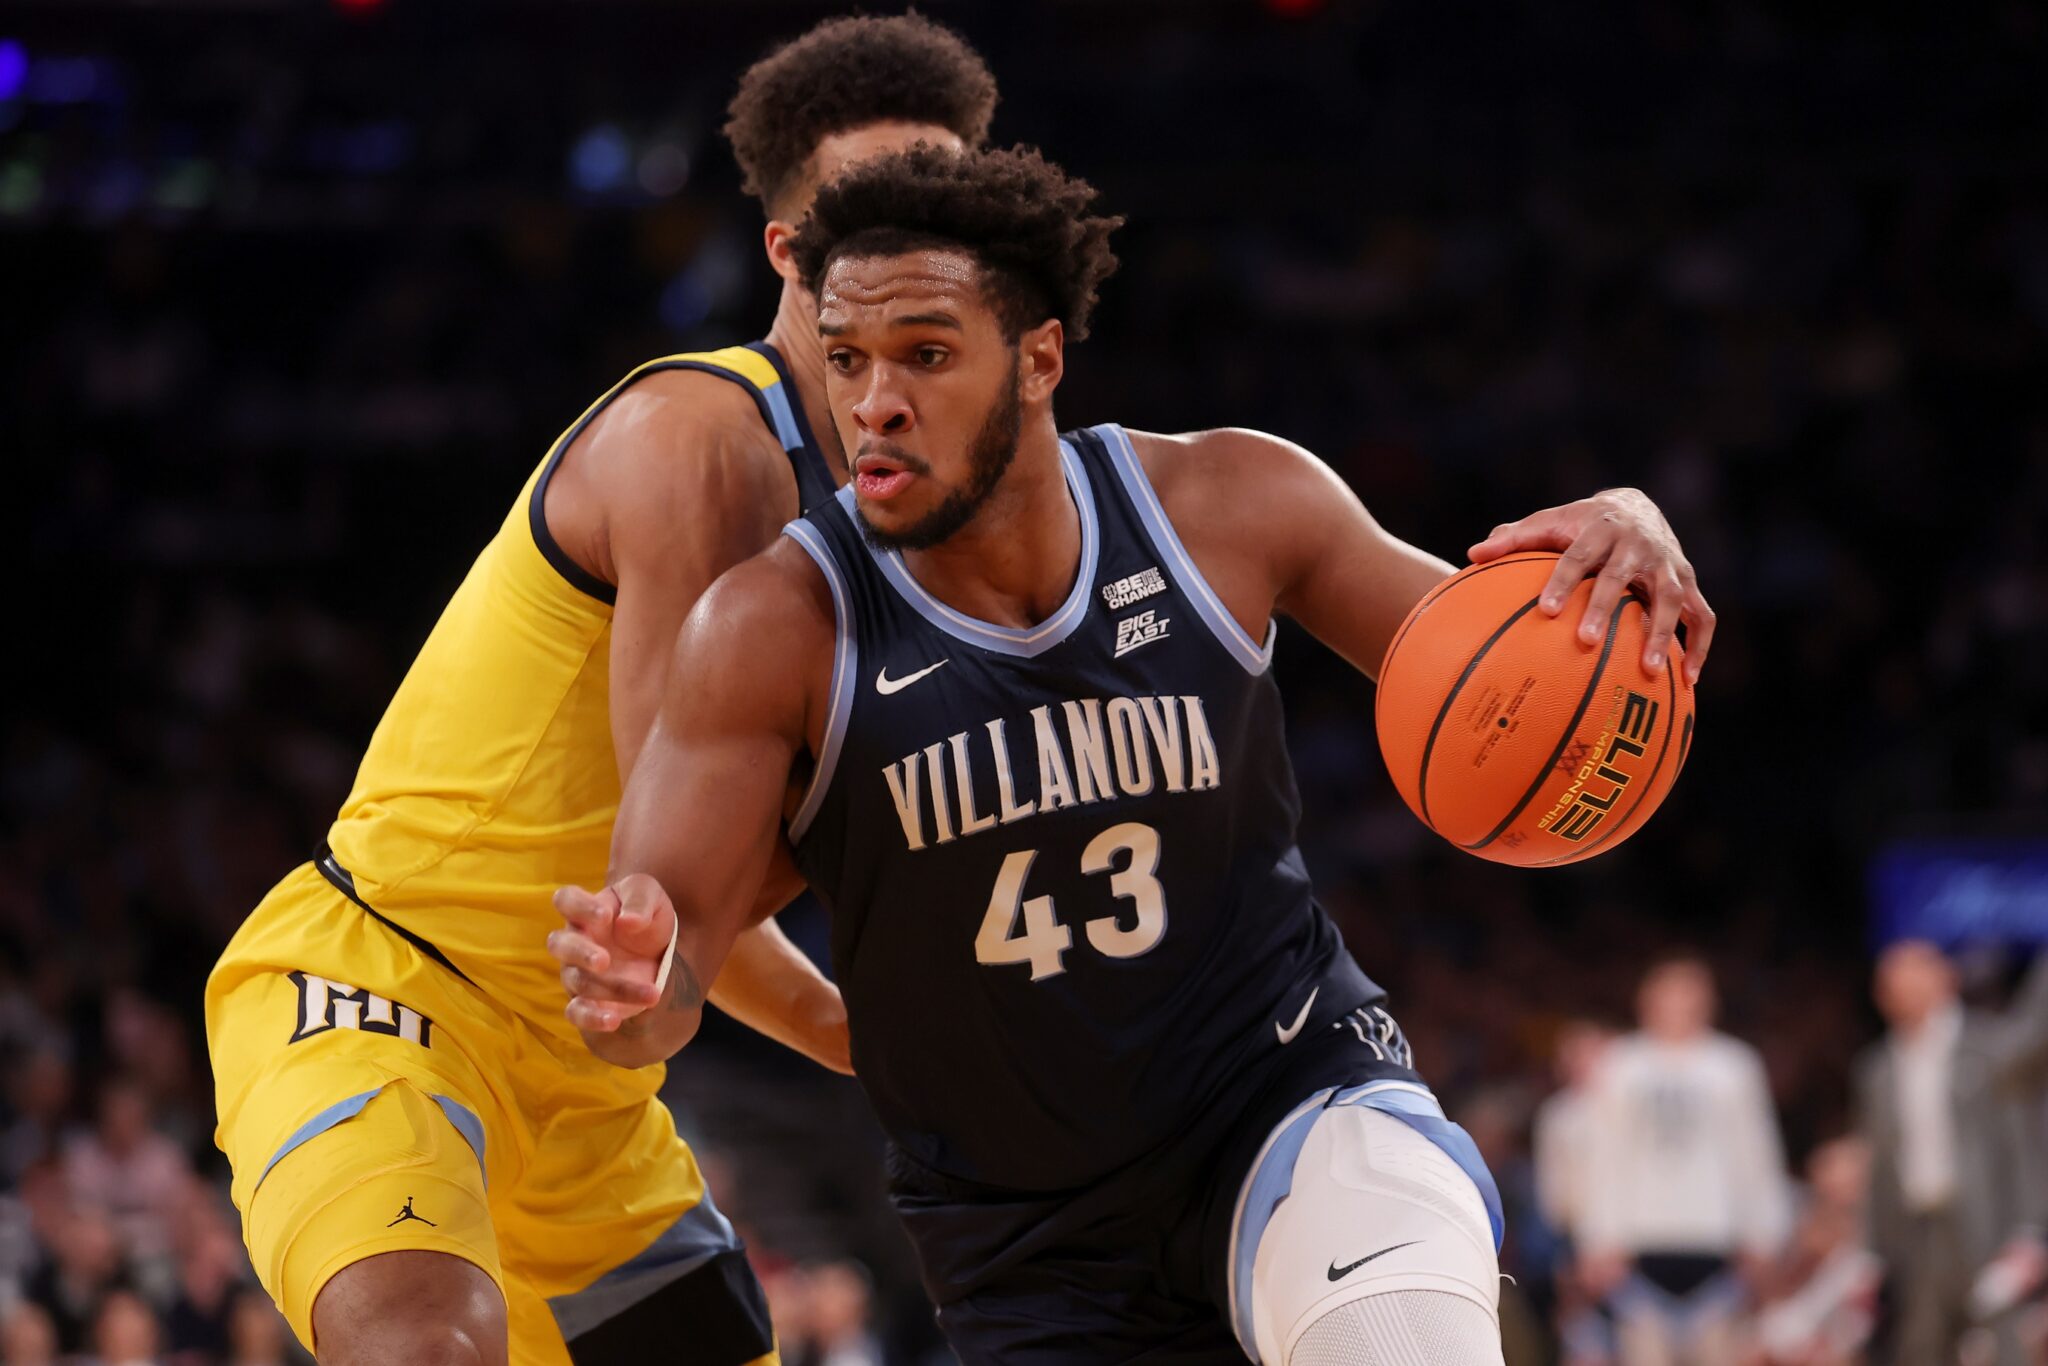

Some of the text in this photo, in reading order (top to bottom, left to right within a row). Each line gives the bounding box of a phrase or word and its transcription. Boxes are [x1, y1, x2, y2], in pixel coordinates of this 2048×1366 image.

[1109, 579, 1166, 609] CHANGE
[1116, 619, 1170, 650] EAST
[1118, 610, 1155, 636] BIG
[882, 695, 1221, 852] VILLANOVA
[1537, 685, 1624, 829] CMPIONSHIP
[974, 821, 1169, 983] 43
